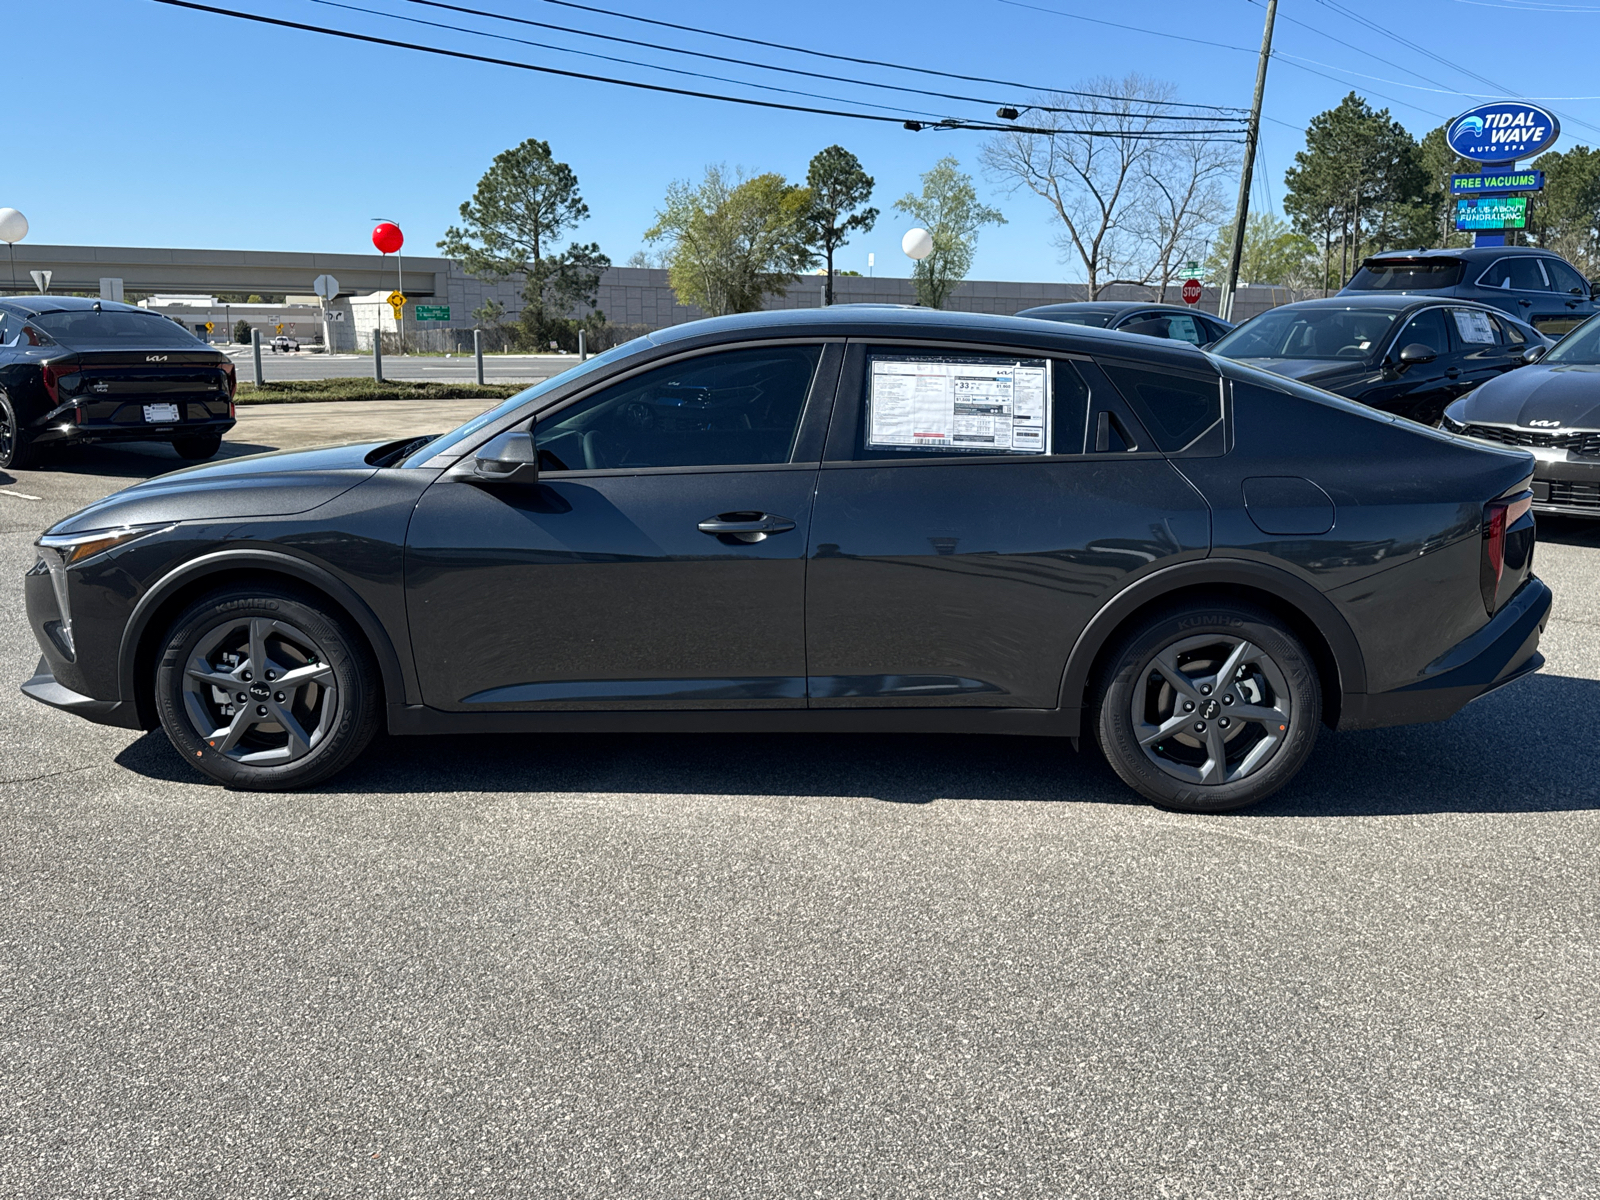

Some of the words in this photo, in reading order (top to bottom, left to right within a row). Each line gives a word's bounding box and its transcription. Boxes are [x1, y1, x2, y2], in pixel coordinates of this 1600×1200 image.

[1484, 112, 1534, 129] TIDAL
[1491, 127, 1545, 144] WAVE
[1470, 145, 1497, 153] AUTO
[1504, 144, 1525, 152] SPA
[1454, 177, 1482, 189] FREE
[1484, 175, 1535, 188] VACUUMS
[1460, 206, 1477, 214] ASK
[1492, 205, 1524, 213] ABOUT
[1460, 212, 1522, 221] FUNDRAISING
[1183, 286, 1201, 297] STOP
[959, 381, 970, 389] 33
[1529, 419, 1561, 427] KIA
[215, 598, 280, 613] KUMHO
[1178, 615, 1244, 630] KUMHO
[250, 687, 270, 697] KIA
[1203, 700, 1217, 719] KIA
[320, 709, 353, 761] SOLUS
